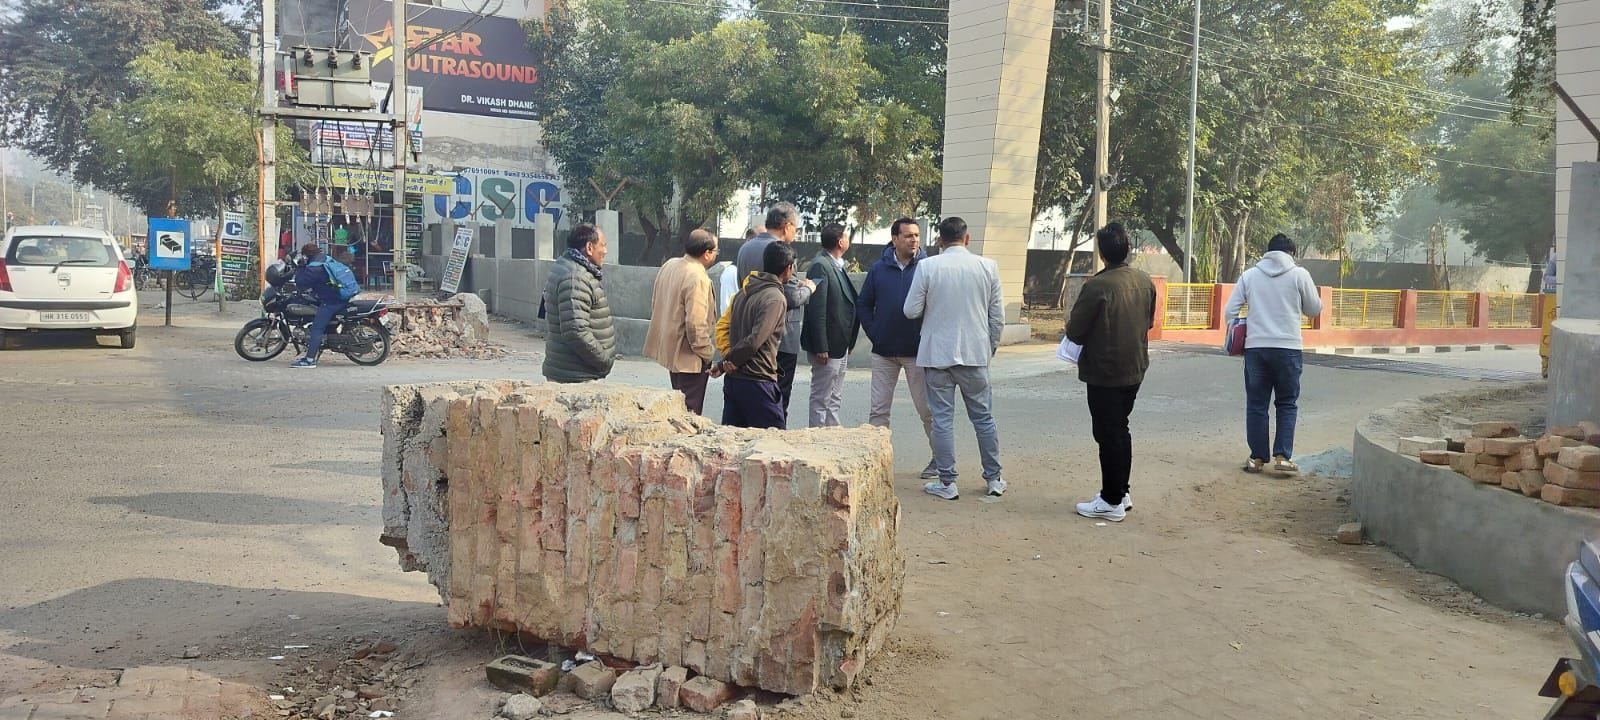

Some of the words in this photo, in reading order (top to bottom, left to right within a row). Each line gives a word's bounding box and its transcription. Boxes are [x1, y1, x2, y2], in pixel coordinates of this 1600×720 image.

[406, 25, 483, 57] STAR
[406, 53, 538, 84] ULTRASOUND
[460, 94, 475, 104] DR.
[476, 96, 507, 107] VIKASH
[508, 99, 538, 110] DHAND
[433, 176, 561, 225] CSC
